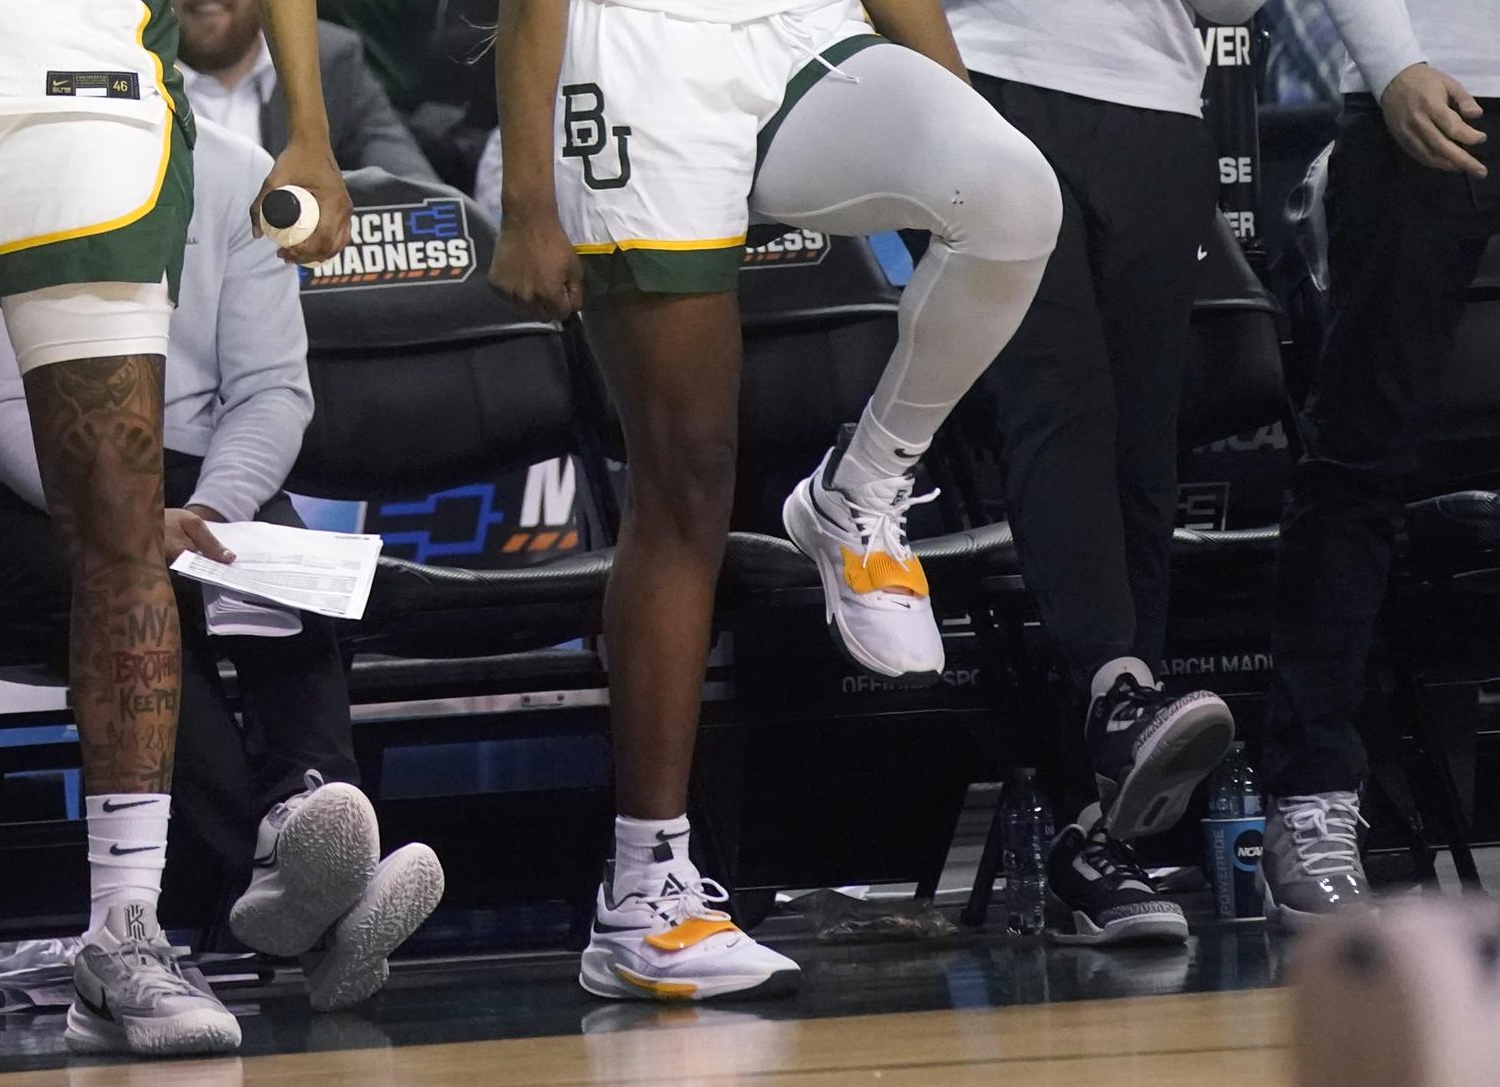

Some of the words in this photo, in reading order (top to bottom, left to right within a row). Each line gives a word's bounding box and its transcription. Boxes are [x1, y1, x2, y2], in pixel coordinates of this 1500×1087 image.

[112, 79, 129, 93] 46
[562, 82, 632, 190] BU
[312, 238, 469, 278] MADNESS
[127, 604, 169, 648] MY
